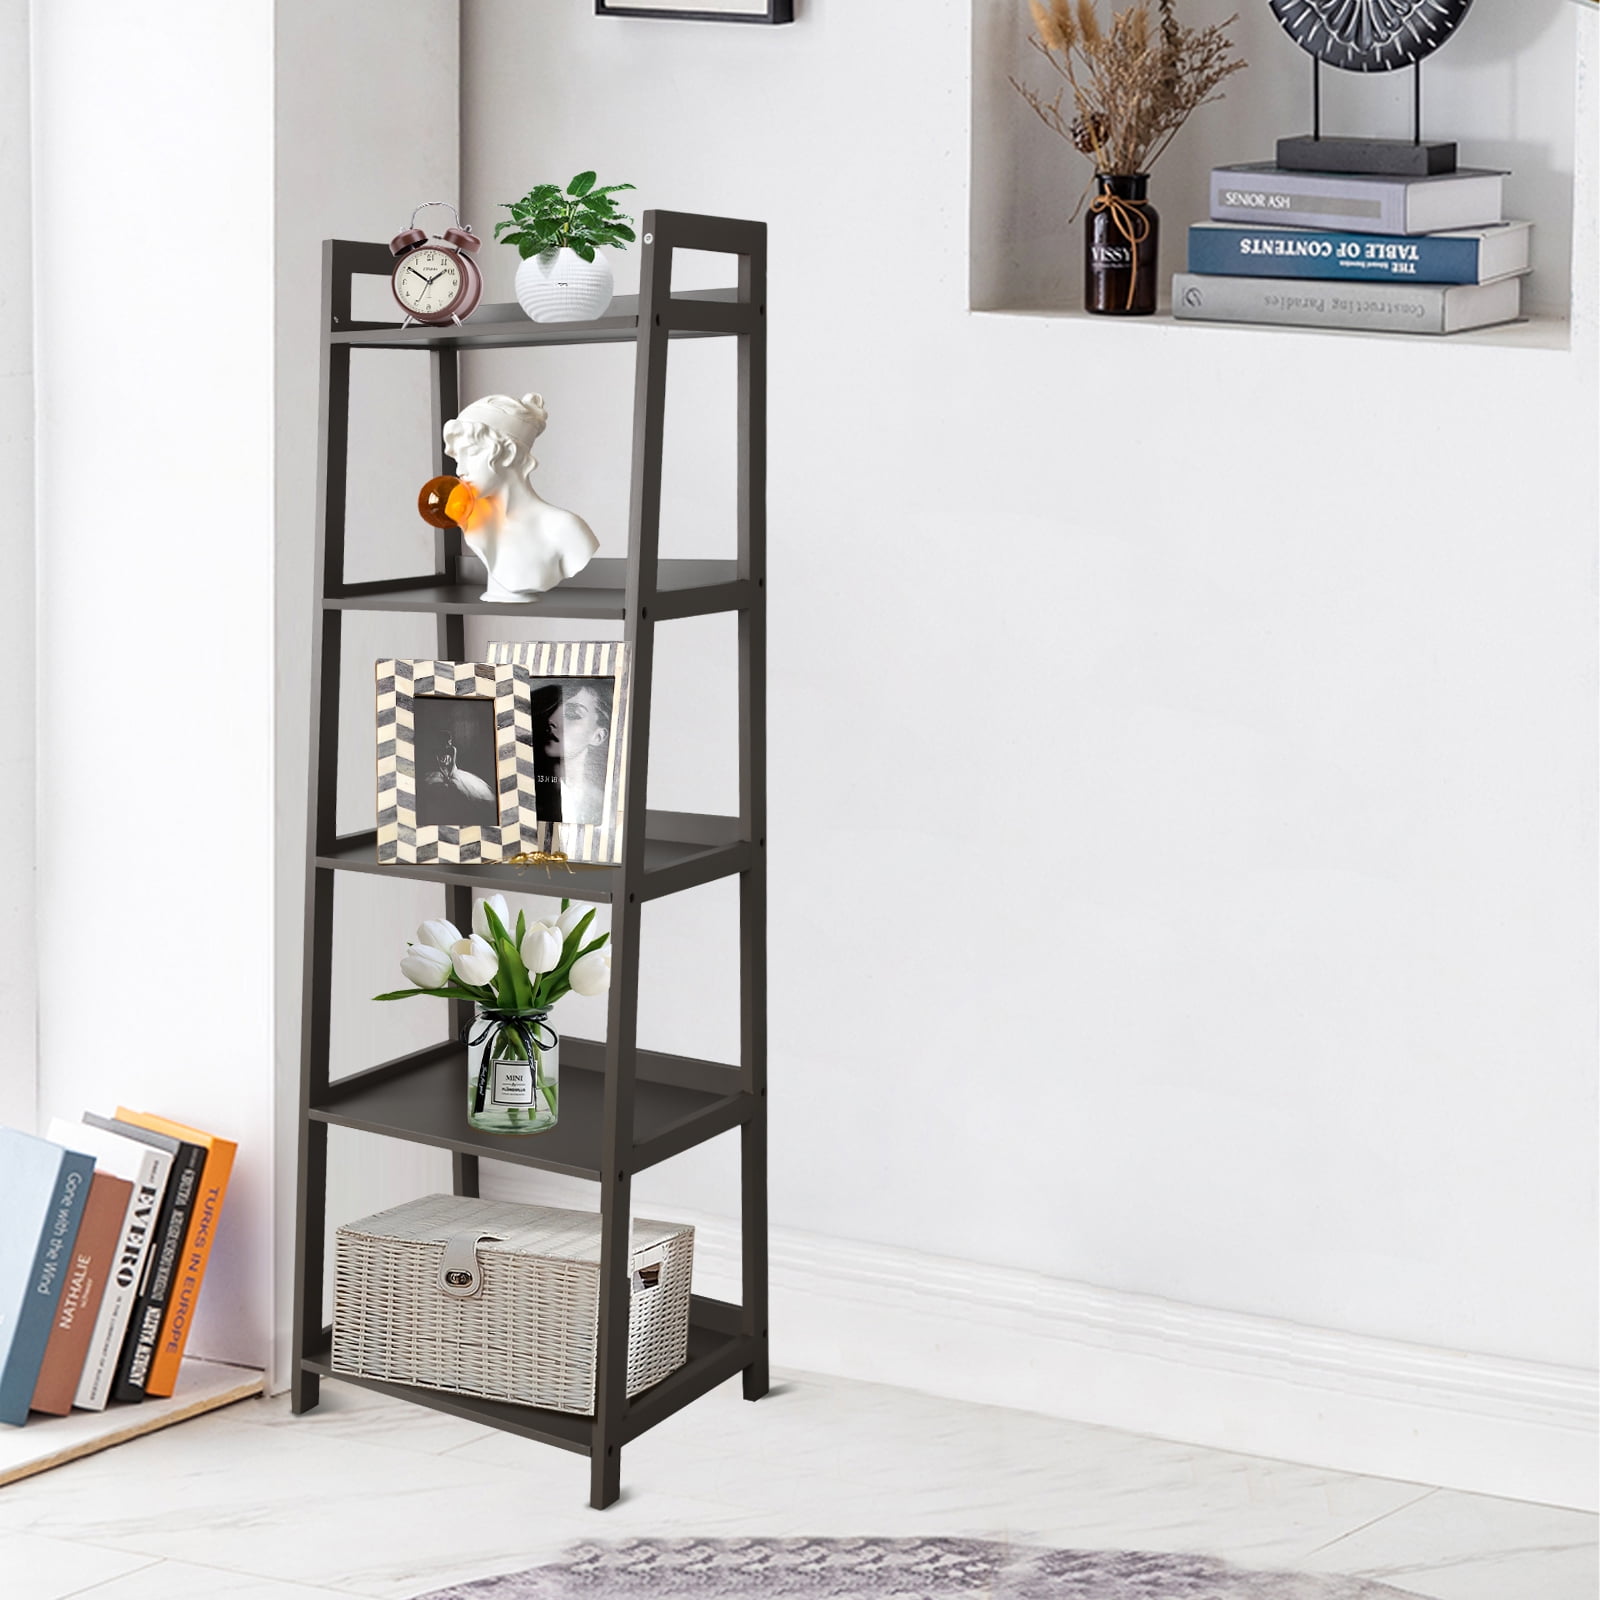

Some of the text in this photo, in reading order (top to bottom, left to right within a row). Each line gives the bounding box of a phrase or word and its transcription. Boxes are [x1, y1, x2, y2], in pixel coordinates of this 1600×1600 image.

[1239, 238, 1420, 260] TABLE OF CONTENTS
[1391, 261, 1417, 274] THE
[1332, 297, 1426, 318] Constructing
[505, 1074, 524, 1082] MINI
[37, 1172, 83, 1295] Gone with the Wind
[116, 1185, 157, 1288] EVERO
[193, 1186, 221, 1249] TURKS
[188, 1252, 202, 1273] IN
[58, 1253, 92, 1330] NATHALIE
[165, 1276, 197, 1354] EUROPE
